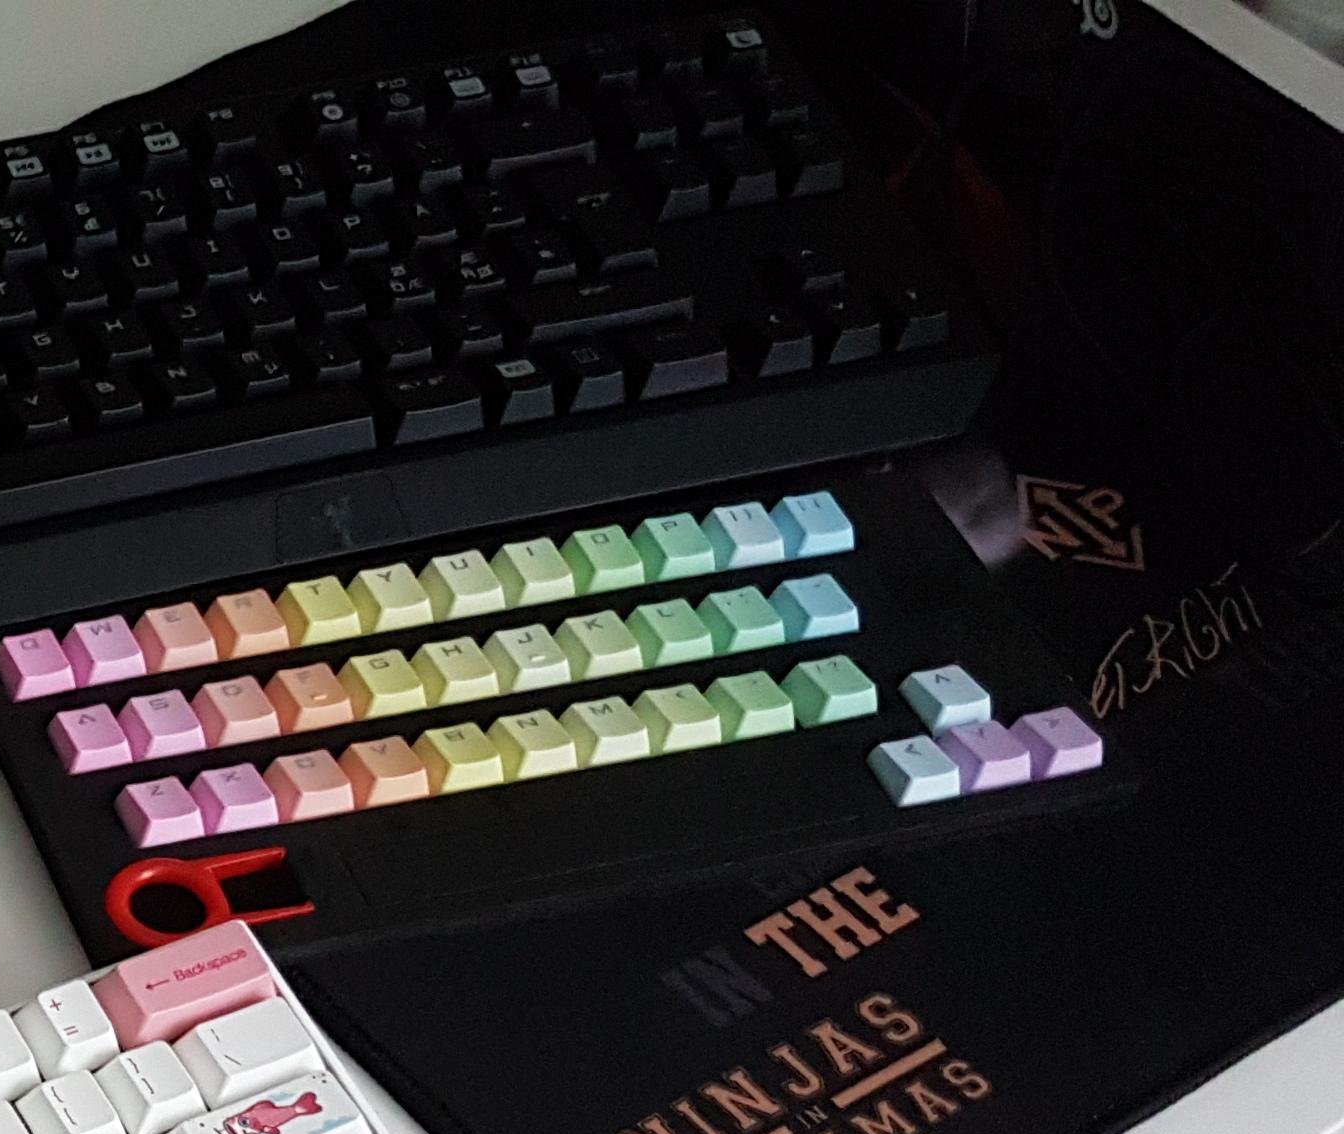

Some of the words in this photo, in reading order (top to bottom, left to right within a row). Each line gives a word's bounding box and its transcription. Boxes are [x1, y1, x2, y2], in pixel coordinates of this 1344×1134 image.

[743, 865, 922, 979] THE
[173, 948, 248, 982] Backspace
[49, 998, 62, 1012] +
[795, 1104, 829, 1129] IN
